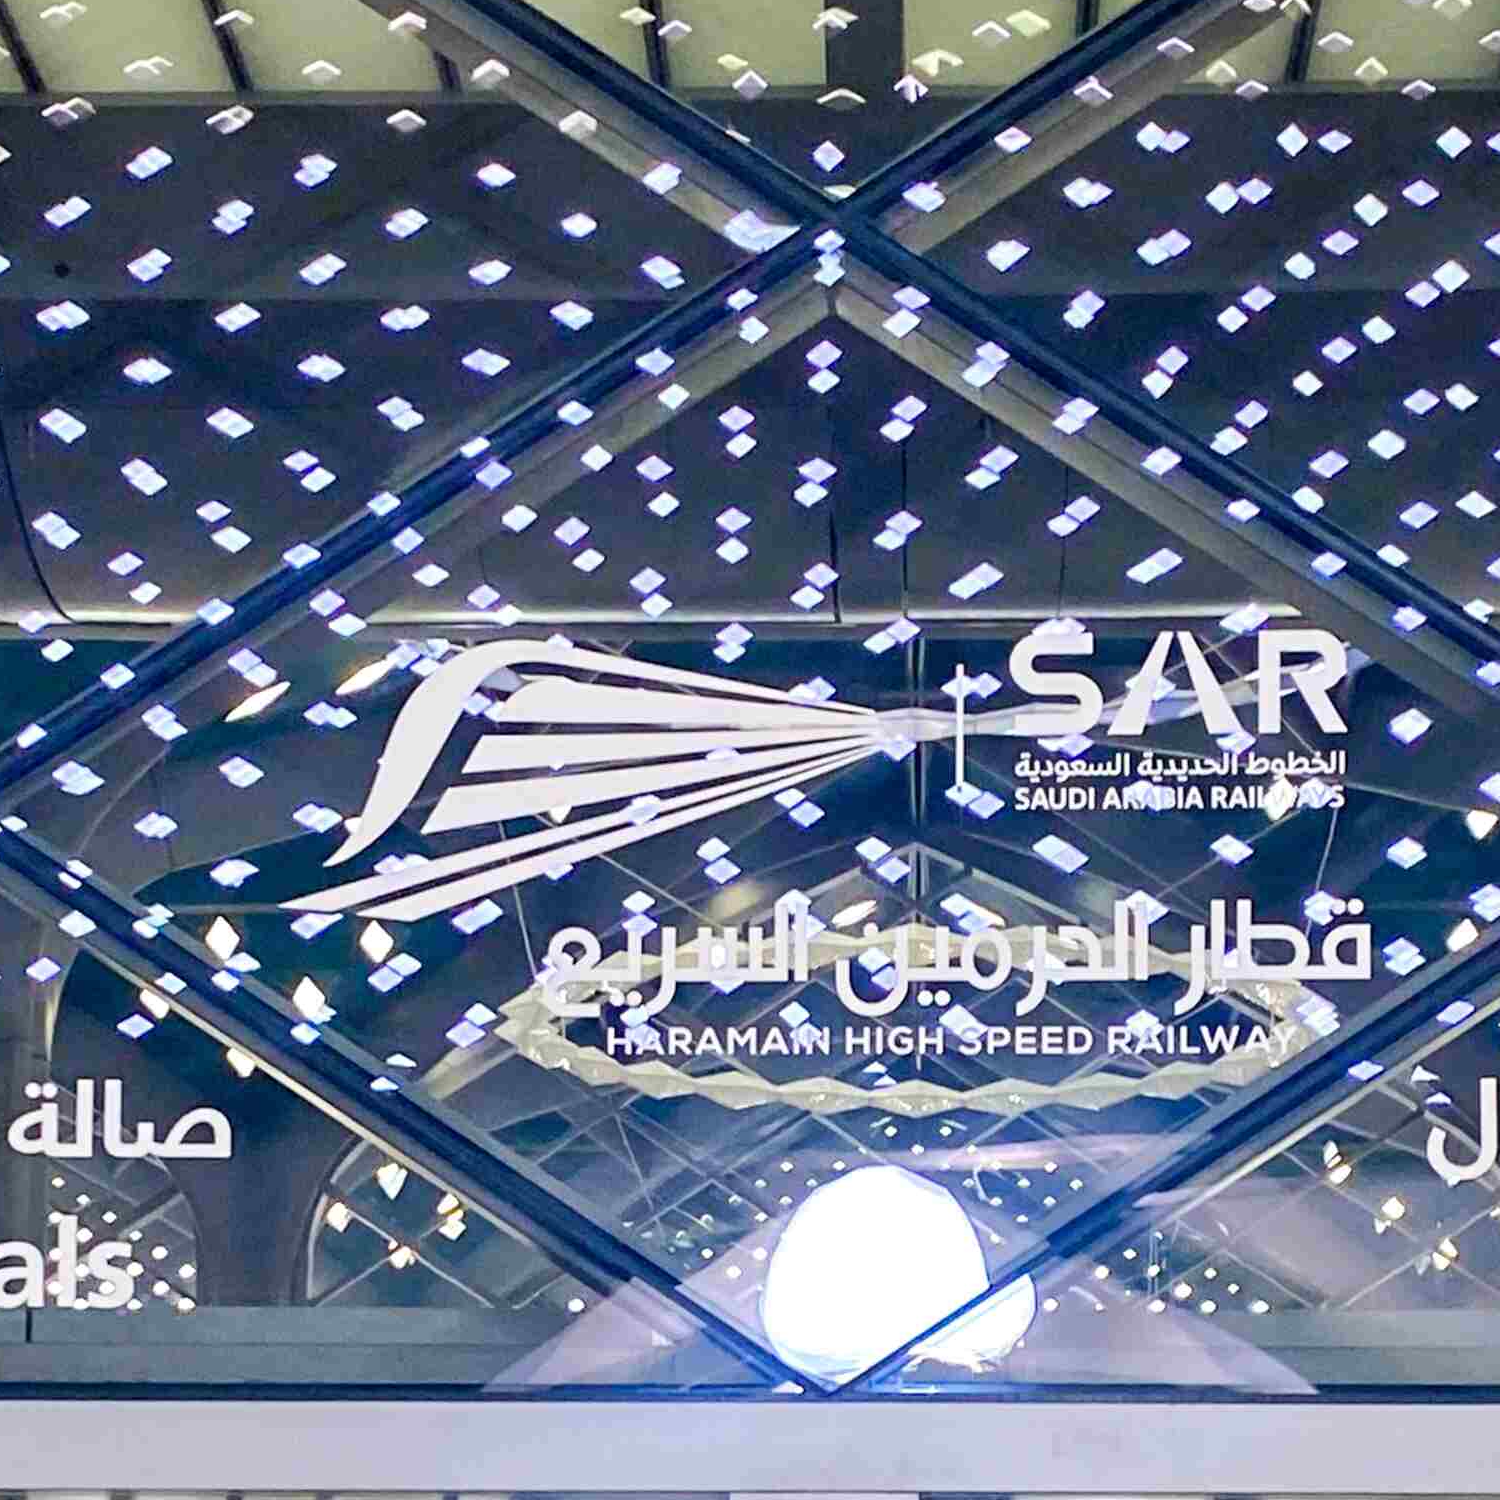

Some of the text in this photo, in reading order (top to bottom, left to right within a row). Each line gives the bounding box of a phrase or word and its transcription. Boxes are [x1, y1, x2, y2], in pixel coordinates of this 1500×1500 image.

[1009, 628, 1348, 736] SAR
[1014, 749, 1346, 784] الخطوط الحديدية السعودية
[1014, 785, 1095, 811] SAUDI
[1101, 785, 1204, 811] ARABIA
[545, 898, 1372, 1018] قطار الحرمين السريع
[606, 1025, 1298, 1056] HARAMAIN HIGH SPEED RAILWAY
[7, 1077, 234, 1160] صالة
